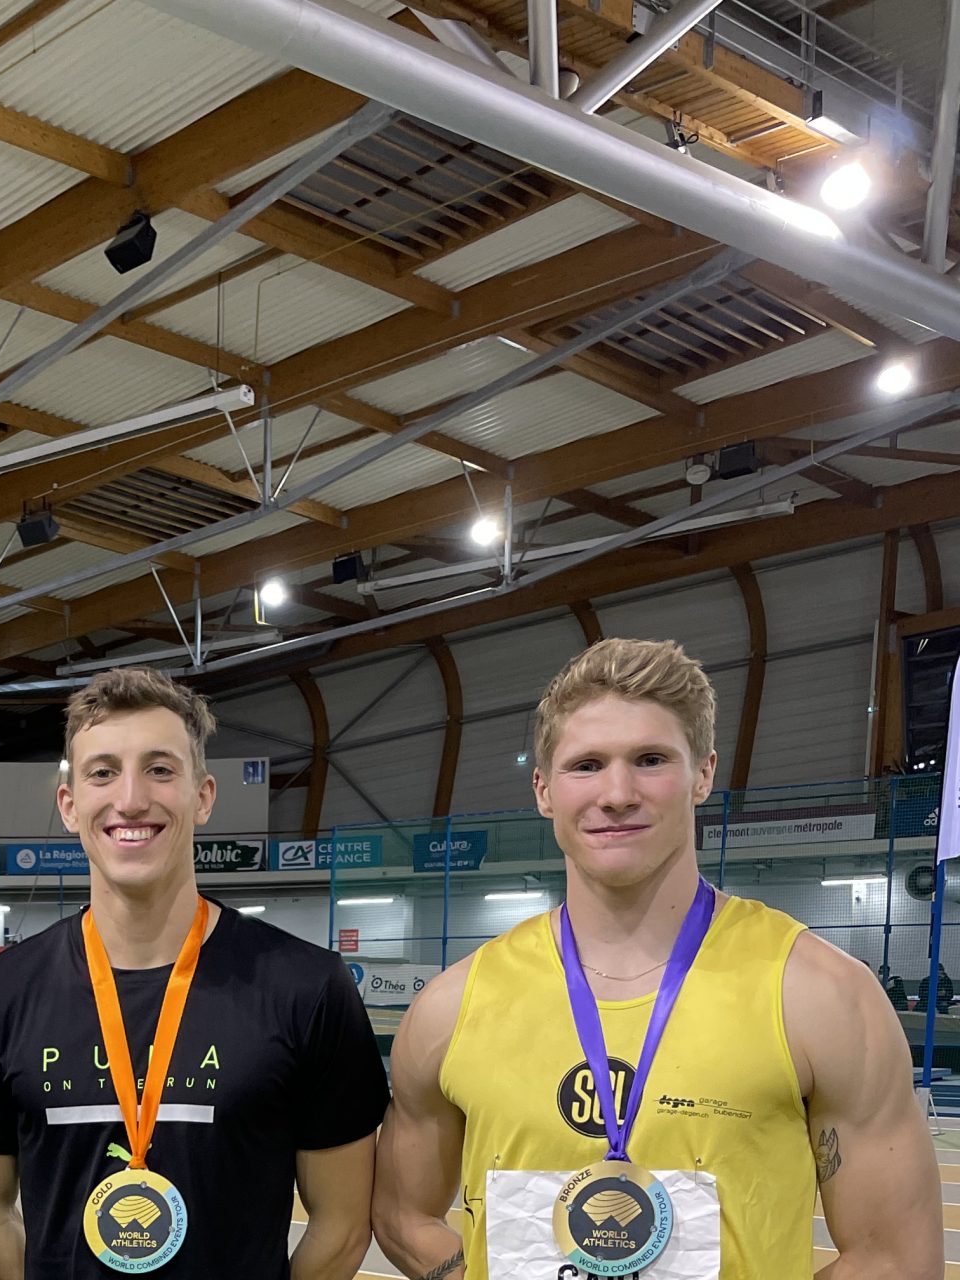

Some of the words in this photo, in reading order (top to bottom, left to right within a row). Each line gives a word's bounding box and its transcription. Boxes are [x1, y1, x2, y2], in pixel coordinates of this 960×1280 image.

[318, 842, 371, 853] CENTRE
[429, 840, 472, 852] Culura
[42, 1045, 220, 1072] PUA
[43, 1079, 72, 1092] ON
[98, 1078, 144, 1089] TE
[166, 1077, 216, 1090] RUN
[698, 1097, 728, 1107] garage
[92, 1181, 113, 1205] GOLD
[559, 1168, 592, 1203] BRONZE
[171, 1195, 183, 1216] TOUR
[654, 1191, 668, 1215] TOUR
[119, 1231, 150, 1240] WORLD
[171, 1217, 184, 1248] EVENTS
[592, 1229, 628, 1239] WORLD
[652, 1216, 668, 1249] EVENTS
[111, 1239, 157, 1248] ATHLETICS
[582, 1238, 636, 1249] ATHLETICS
[108, 1256, 135, 1270] WORLD
[136, 1247, 173, 1270] COMBINED
[579, 1256, 609, 1273] WORLD
[611, 1247, 654, 1273] COMBINED
